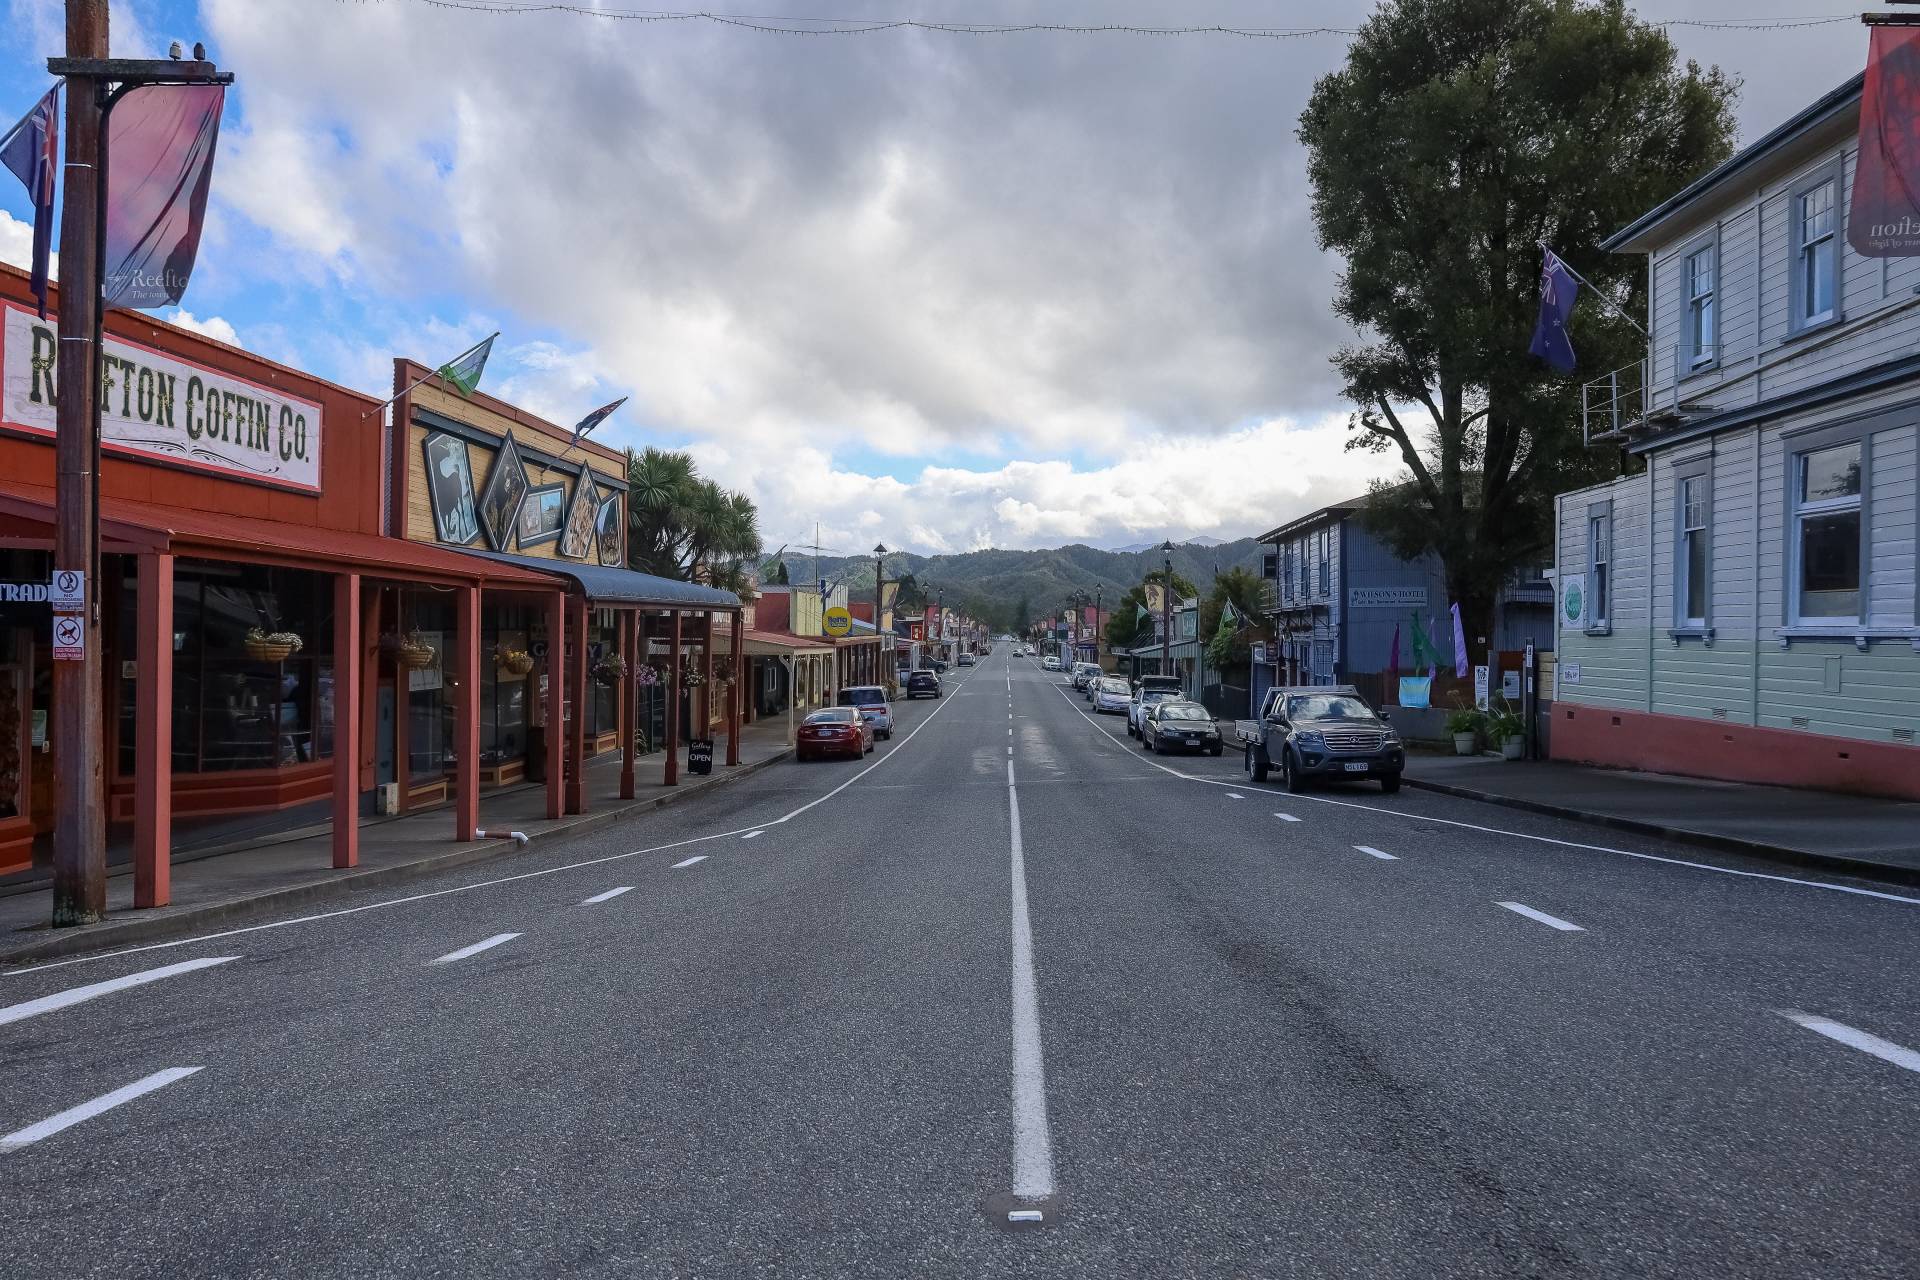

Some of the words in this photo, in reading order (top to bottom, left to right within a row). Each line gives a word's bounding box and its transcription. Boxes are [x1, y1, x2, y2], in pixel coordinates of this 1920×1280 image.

[132, 290, 147, 299] The
[30, 325, 176, 428] RFTON
[186, 375, 271, 452] COFFIN
[279, 404, 309, 463] CO.
[1359, 590, 1397, 598] WILSON'S
[1399, 590, 1425, 598] HOTEL
[689, 753, 711, 762] OPEN
